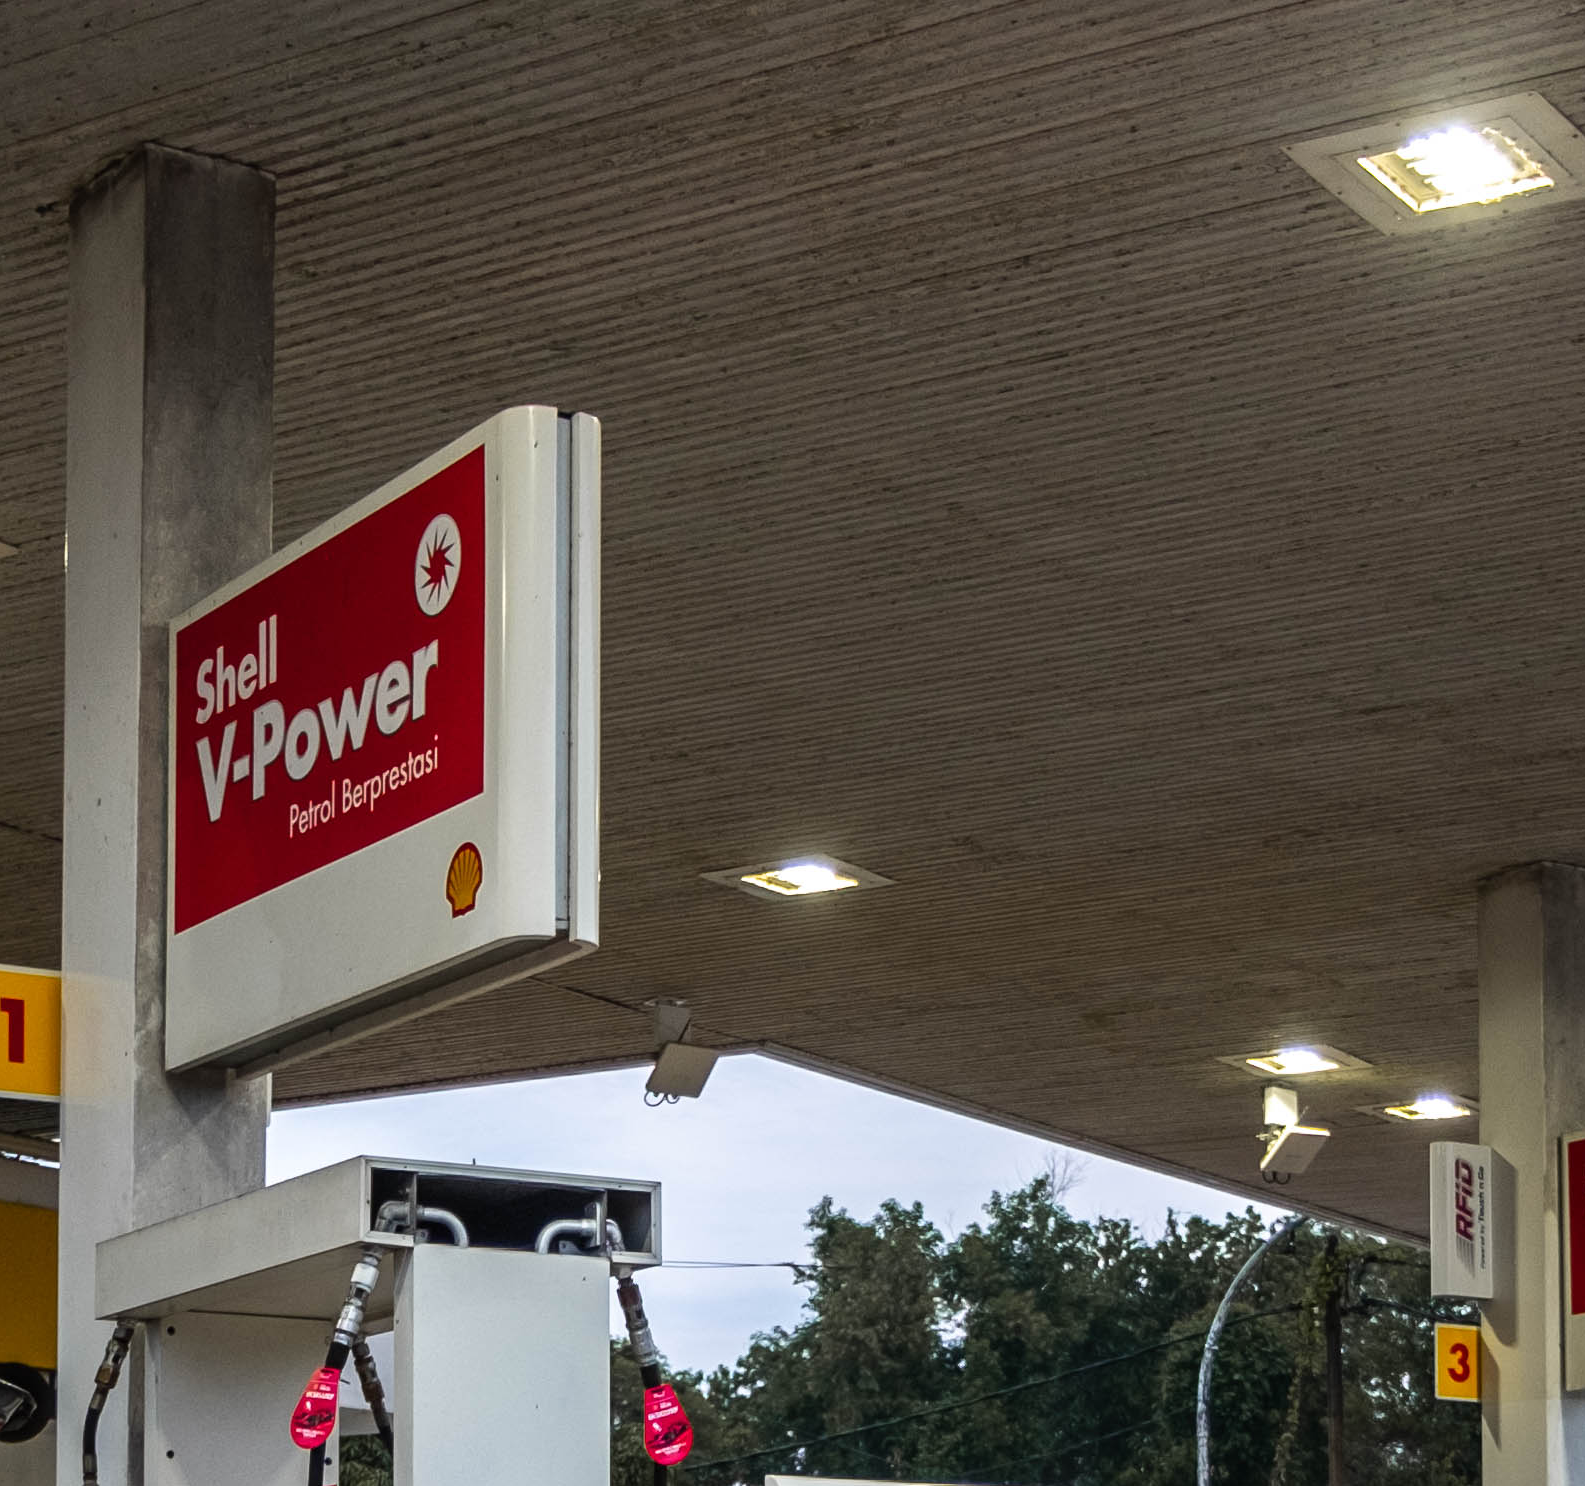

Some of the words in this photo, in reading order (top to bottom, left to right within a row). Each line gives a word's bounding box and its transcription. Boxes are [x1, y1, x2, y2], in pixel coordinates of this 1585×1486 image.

[194, 615, 277, 724] Shell
[196, 639, 439, 822] V-Power
[289, 781, 336, 838] Petrol
[342, 736, 438, 809] Berprestasi
[0, 998, 25, 1064] 1
[1447, 1342, 1470, 1383] 3
